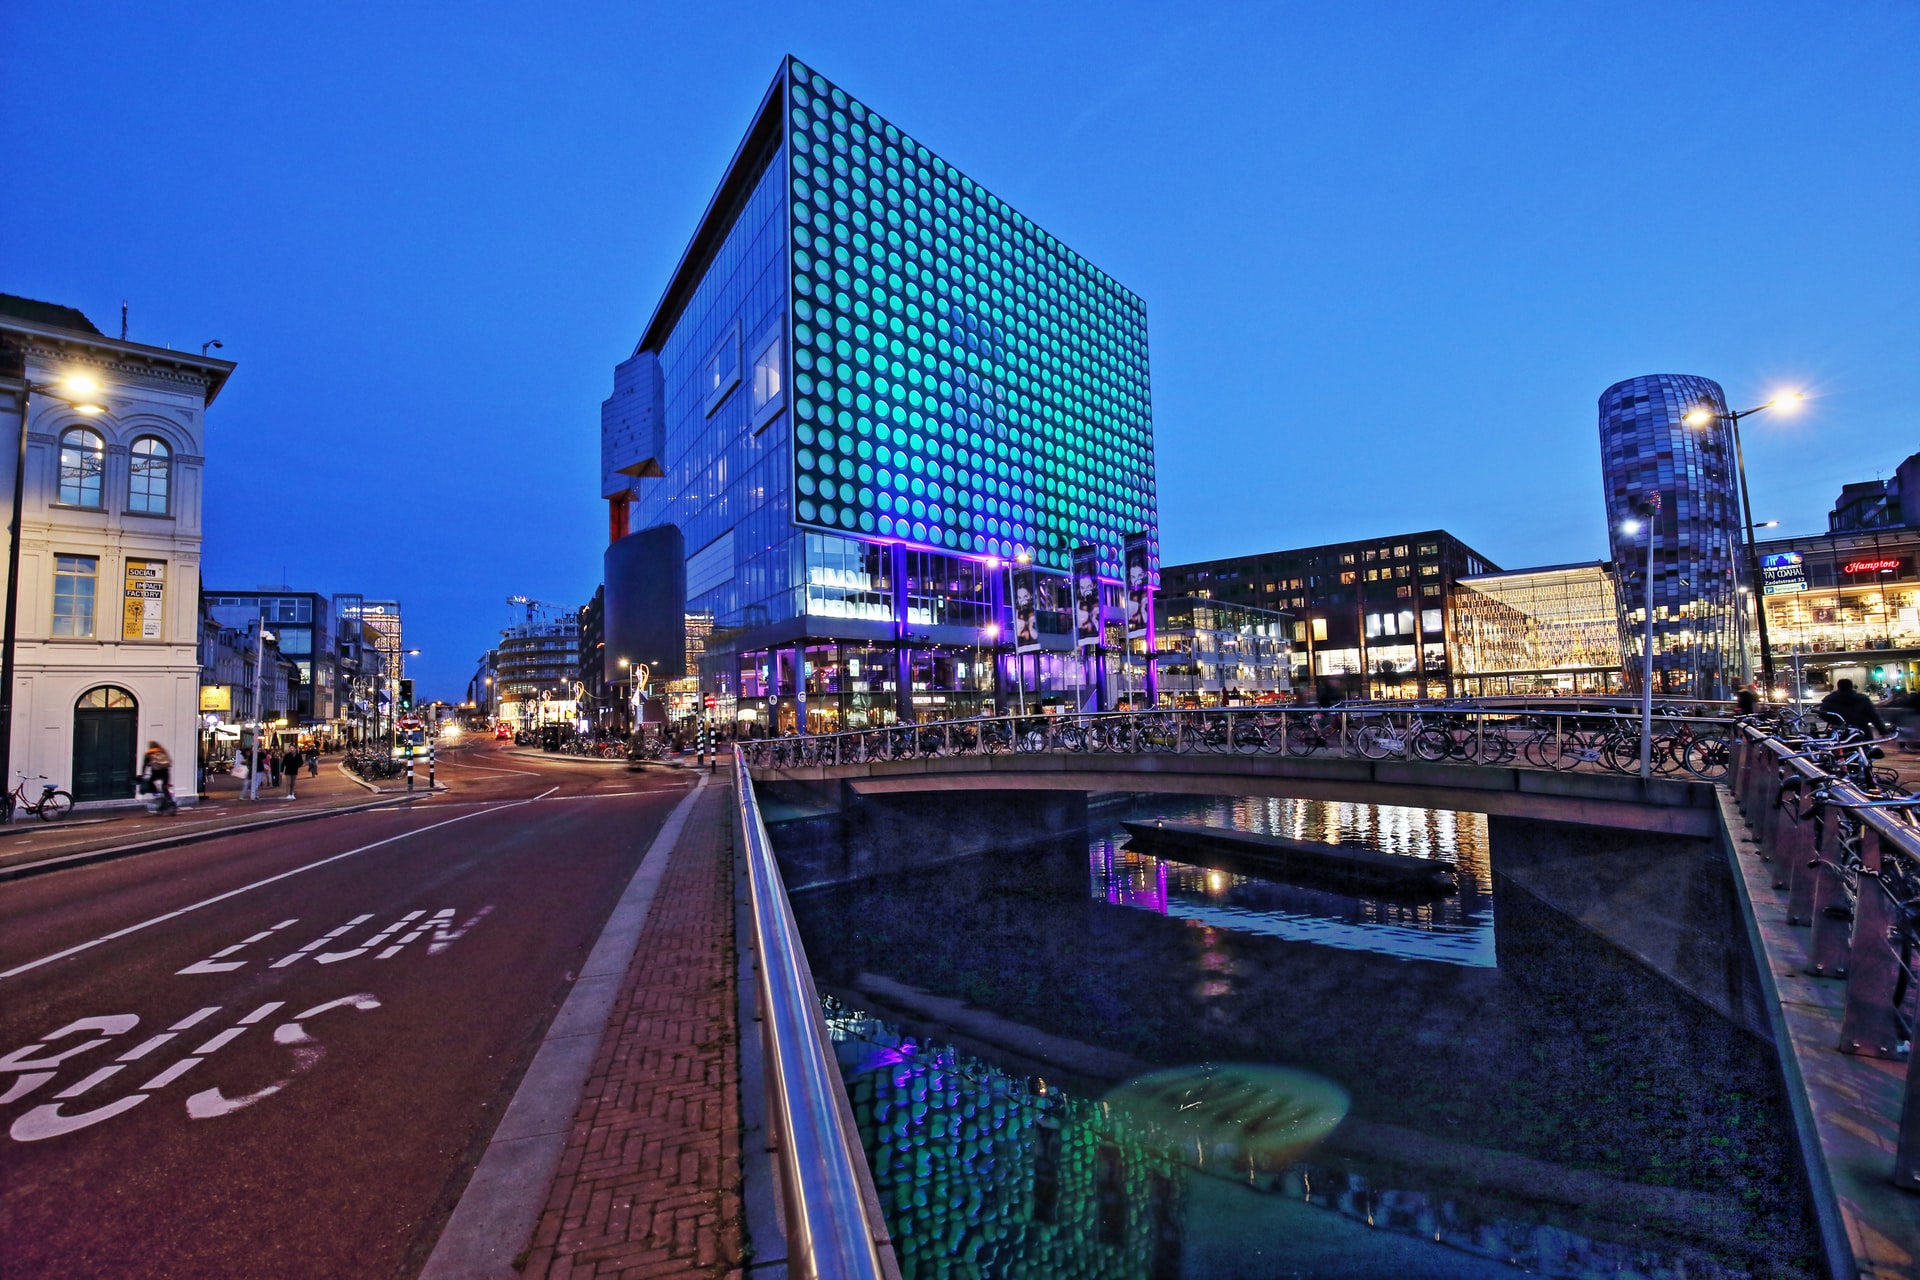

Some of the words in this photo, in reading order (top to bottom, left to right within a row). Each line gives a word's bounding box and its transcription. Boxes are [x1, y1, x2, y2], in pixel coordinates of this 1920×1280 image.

[1845, 560, 1899, 572] Hampton
[129, 569, 155, 577] SOCIAL
[1763, 571, 1775, 580] TAJ
[136, 582, 163, 590] IMPACT
[127, 590, 160, 598] FACTORY
[174, 904, 496, 975] LIJN
